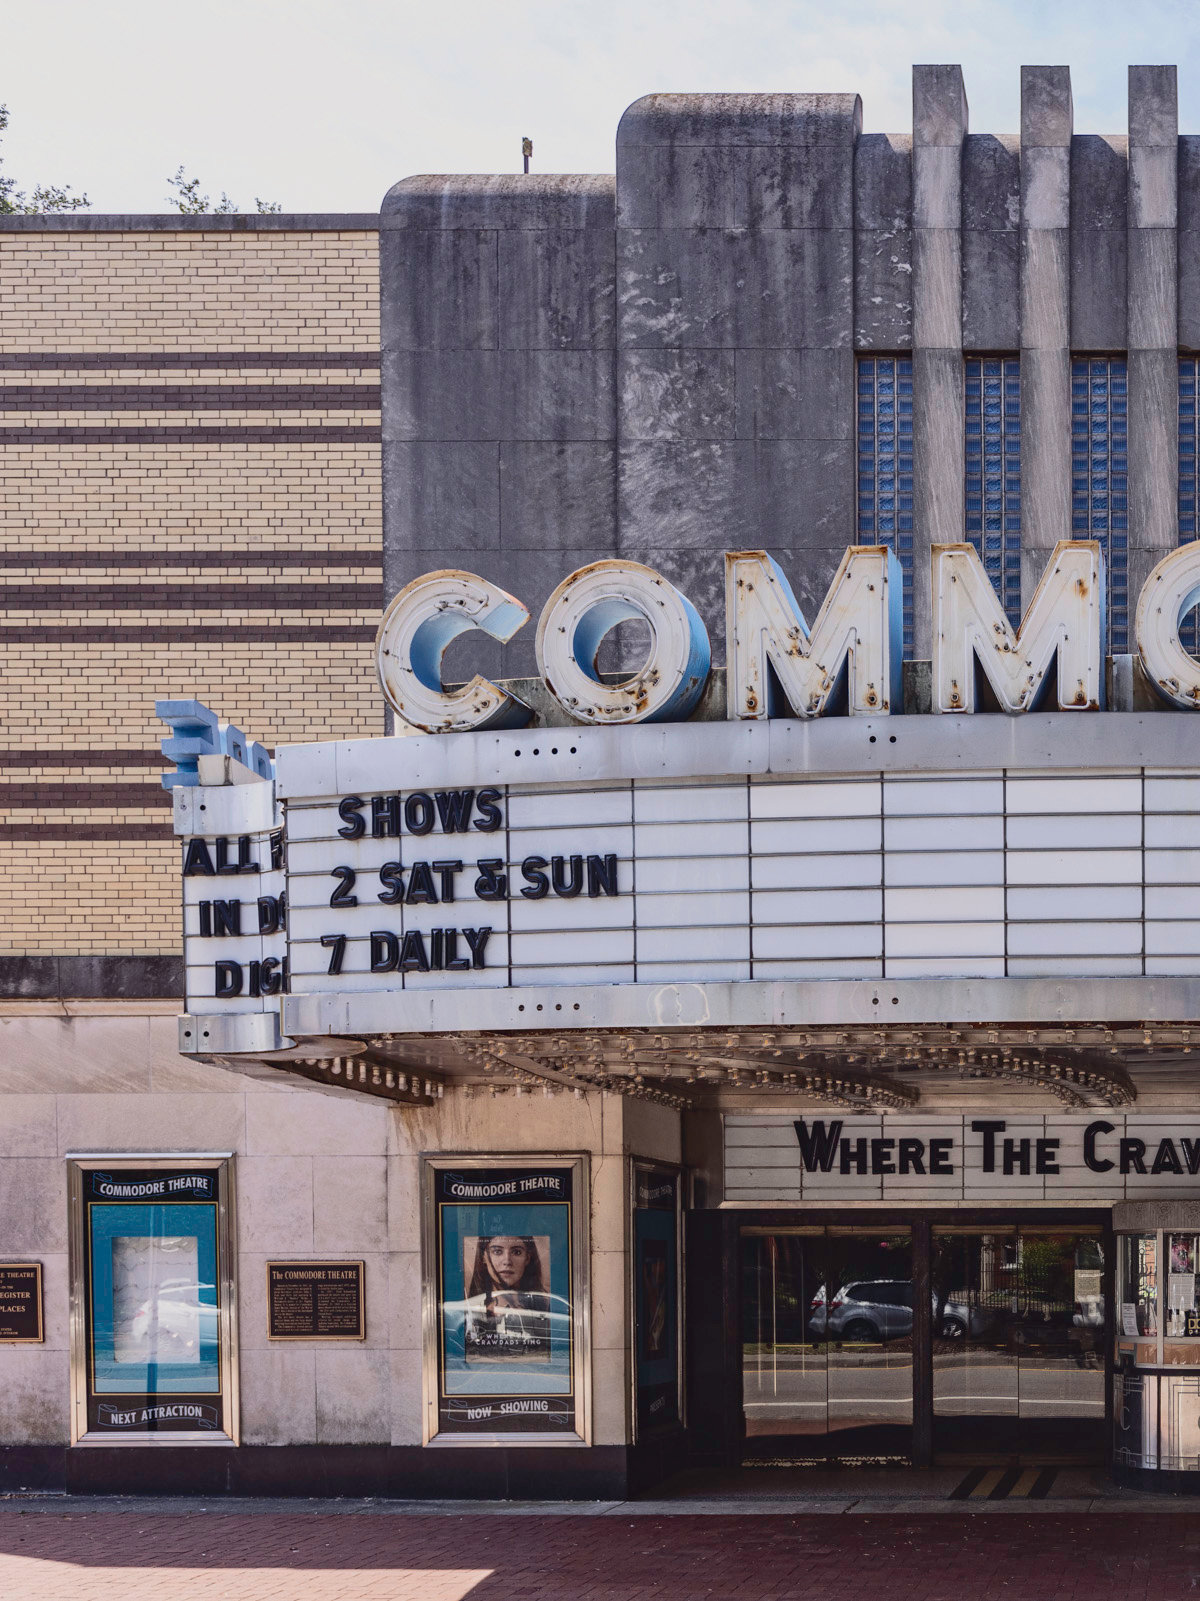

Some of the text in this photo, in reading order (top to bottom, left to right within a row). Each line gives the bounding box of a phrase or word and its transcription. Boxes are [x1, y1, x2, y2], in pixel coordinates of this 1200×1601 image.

[337, 788, 503, 840] SHOWS
[183, 836, 259, 876] ALL
[330, 854, 617, 908] 2 SAT & SUN
[199, 899, 240, 937] IN
[320, 926, 492, 975] 7 DAILY
[100, 1177, 208, 1196] COMMODORE THEATRE
[451, 1177, 560, 1197] COMMODORE THEATRE
[272, 1271, 357, 1280] The COMMODORE THEATRE
[111, 1406, 203, 1424] NEXT ATTRACTION
[467, 1401, 548, 1419] NOW SHOWING
